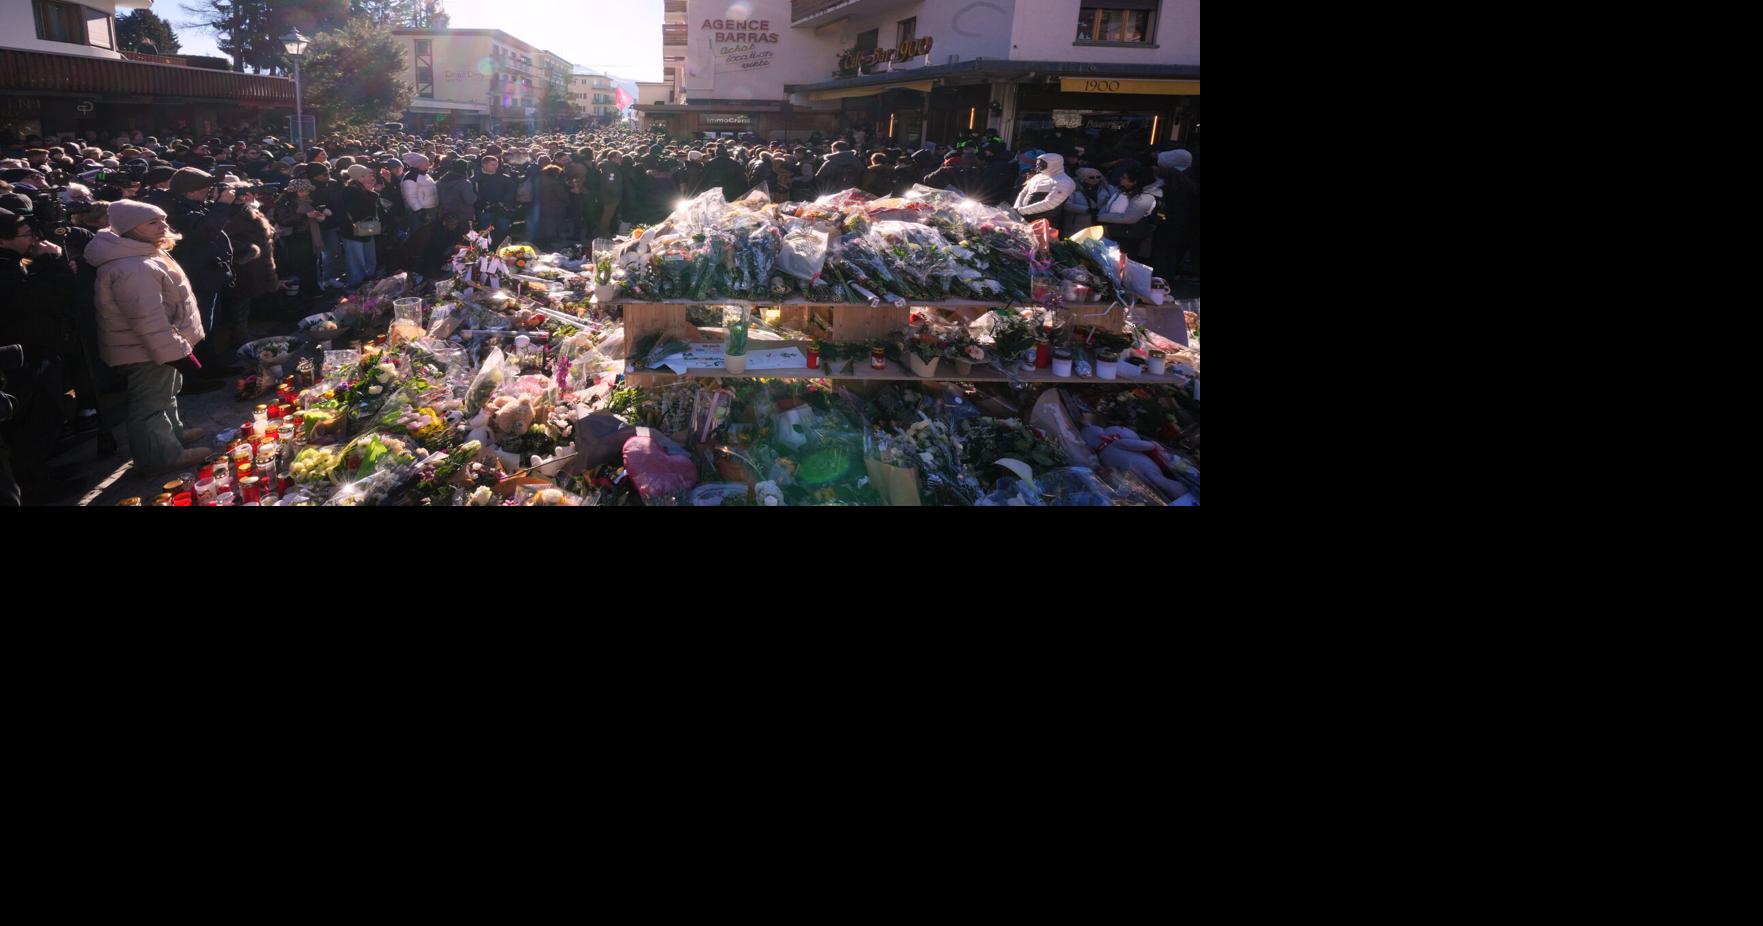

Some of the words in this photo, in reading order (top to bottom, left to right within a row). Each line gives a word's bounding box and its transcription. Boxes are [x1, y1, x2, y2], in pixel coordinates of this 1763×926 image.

[701, 19, 769, 31] AGENCE
[715, 32, 779, 43] BARRAS
[1084, 80, 1120, 92] 1900
